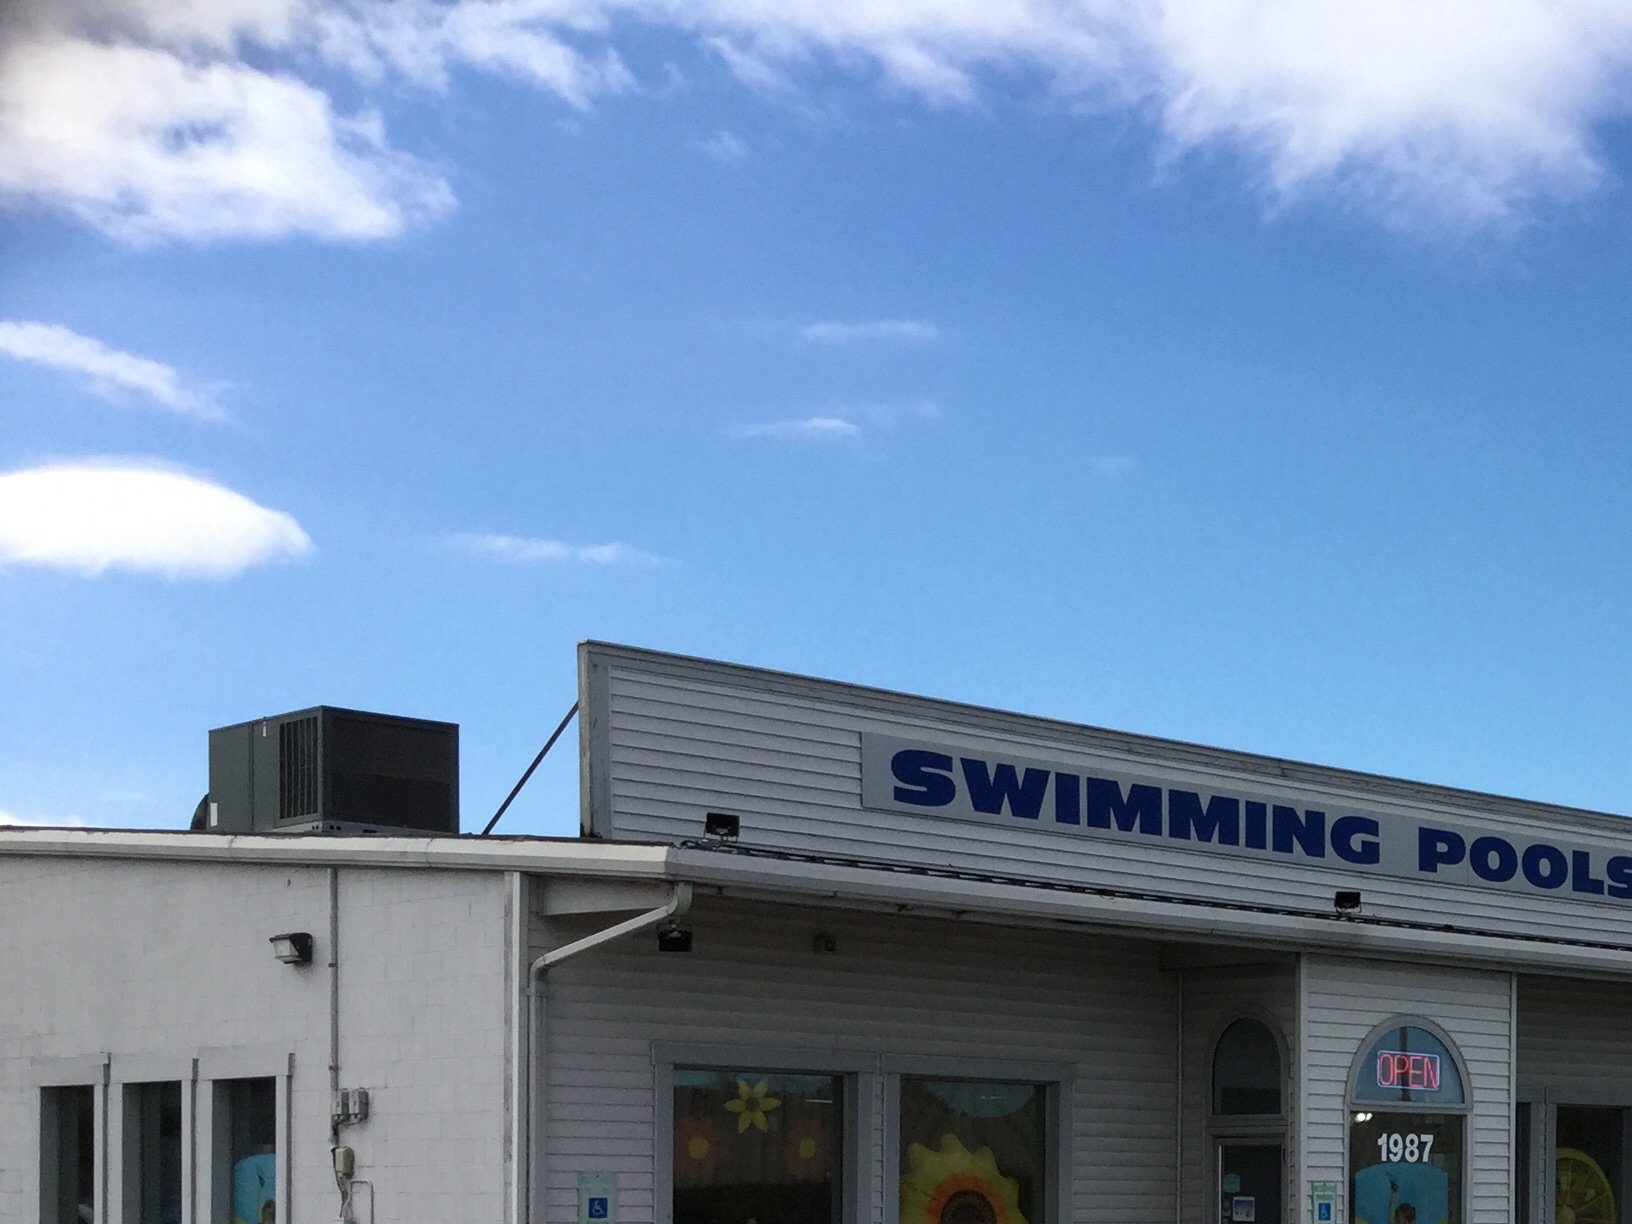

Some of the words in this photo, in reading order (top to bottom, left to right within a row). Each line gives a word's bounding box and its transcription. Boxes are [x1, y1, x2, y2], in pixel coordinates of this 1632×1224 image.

[890, 749, 1380, 865] SWIMMING
[1380, 1054, 1439, 1088] OPEN
[1377, 1132, 1434, 1163] 1987
